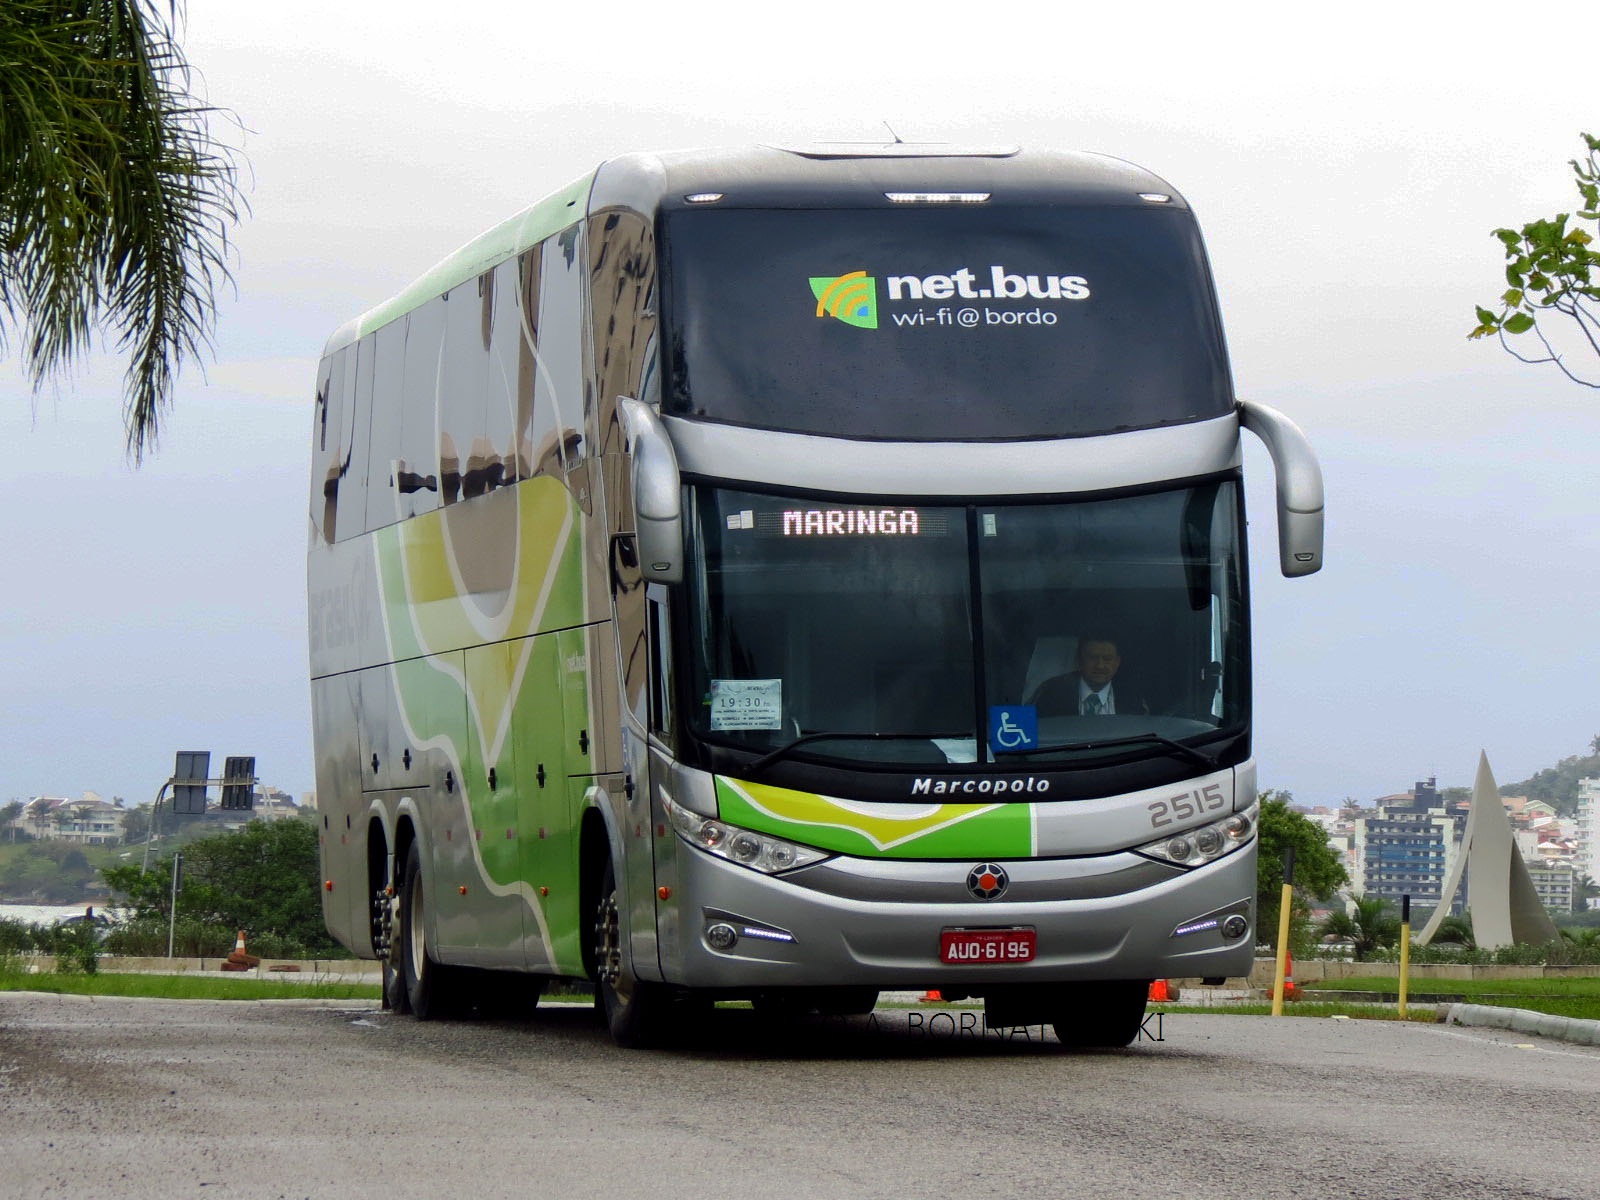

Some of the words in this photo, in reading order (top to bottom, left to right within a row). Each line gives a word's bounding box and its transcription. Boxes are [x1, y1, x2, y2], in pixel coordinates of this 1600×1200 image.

[886, 265, 1091, 301] net.bus
[892, 307, 953, 326] wi-fi
[956, 307, 980, 328] @
[985, 307, 1058, 326] bordo
[783, 509, 919, 535] MARINGA
[911, 776, 1051, 795] Marcopolo
[1146, 783, 1225, 828] 2515
